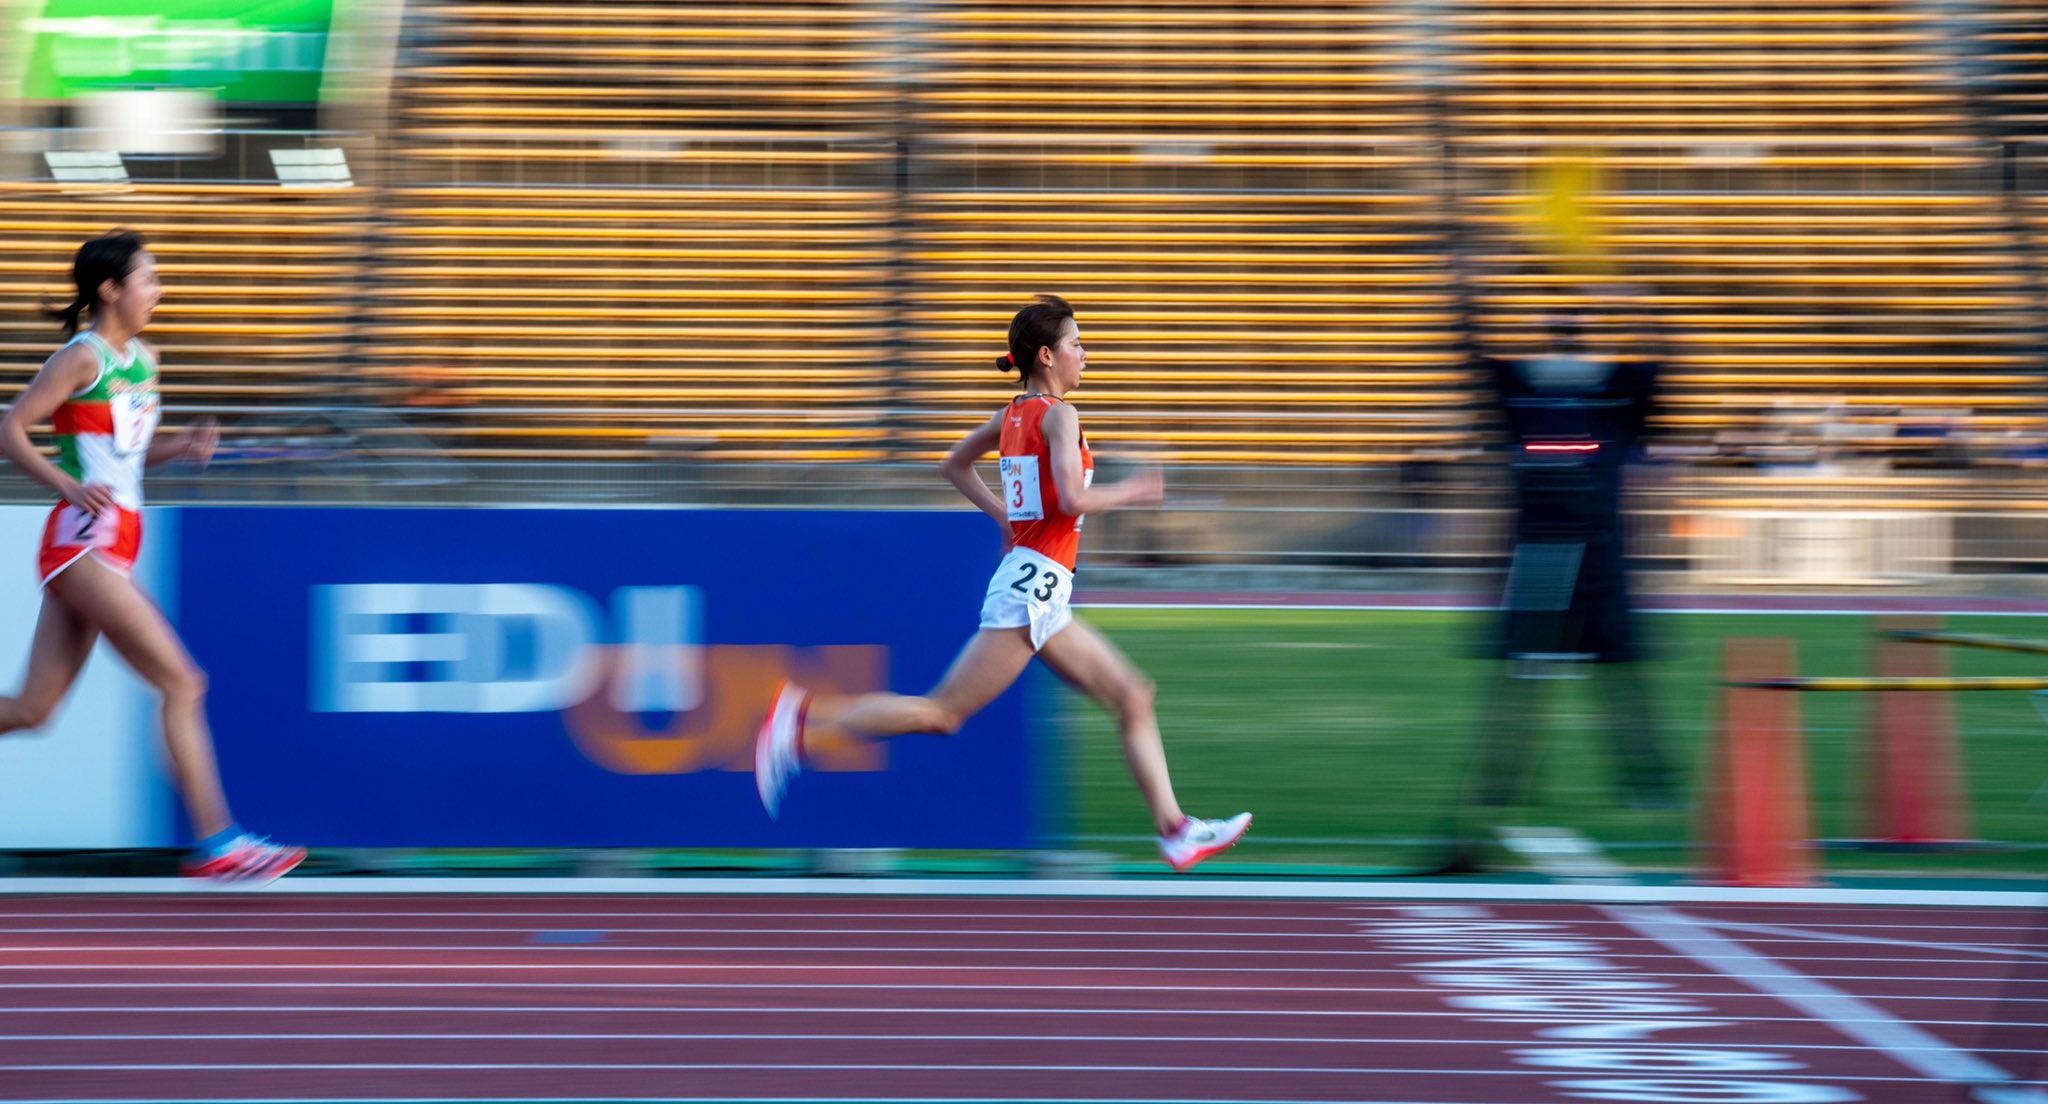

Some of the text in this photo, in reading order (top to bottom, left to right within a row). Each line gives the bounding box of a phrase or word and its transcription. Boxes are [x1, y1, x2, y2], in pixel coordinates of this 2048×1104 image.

[1005, 480, 1024, 508] 3
[1010, 562, 1058, 602] 23
[1503, 1048, 1812, 1071] 8
[1541, 1079, 1864, 1103] 9
